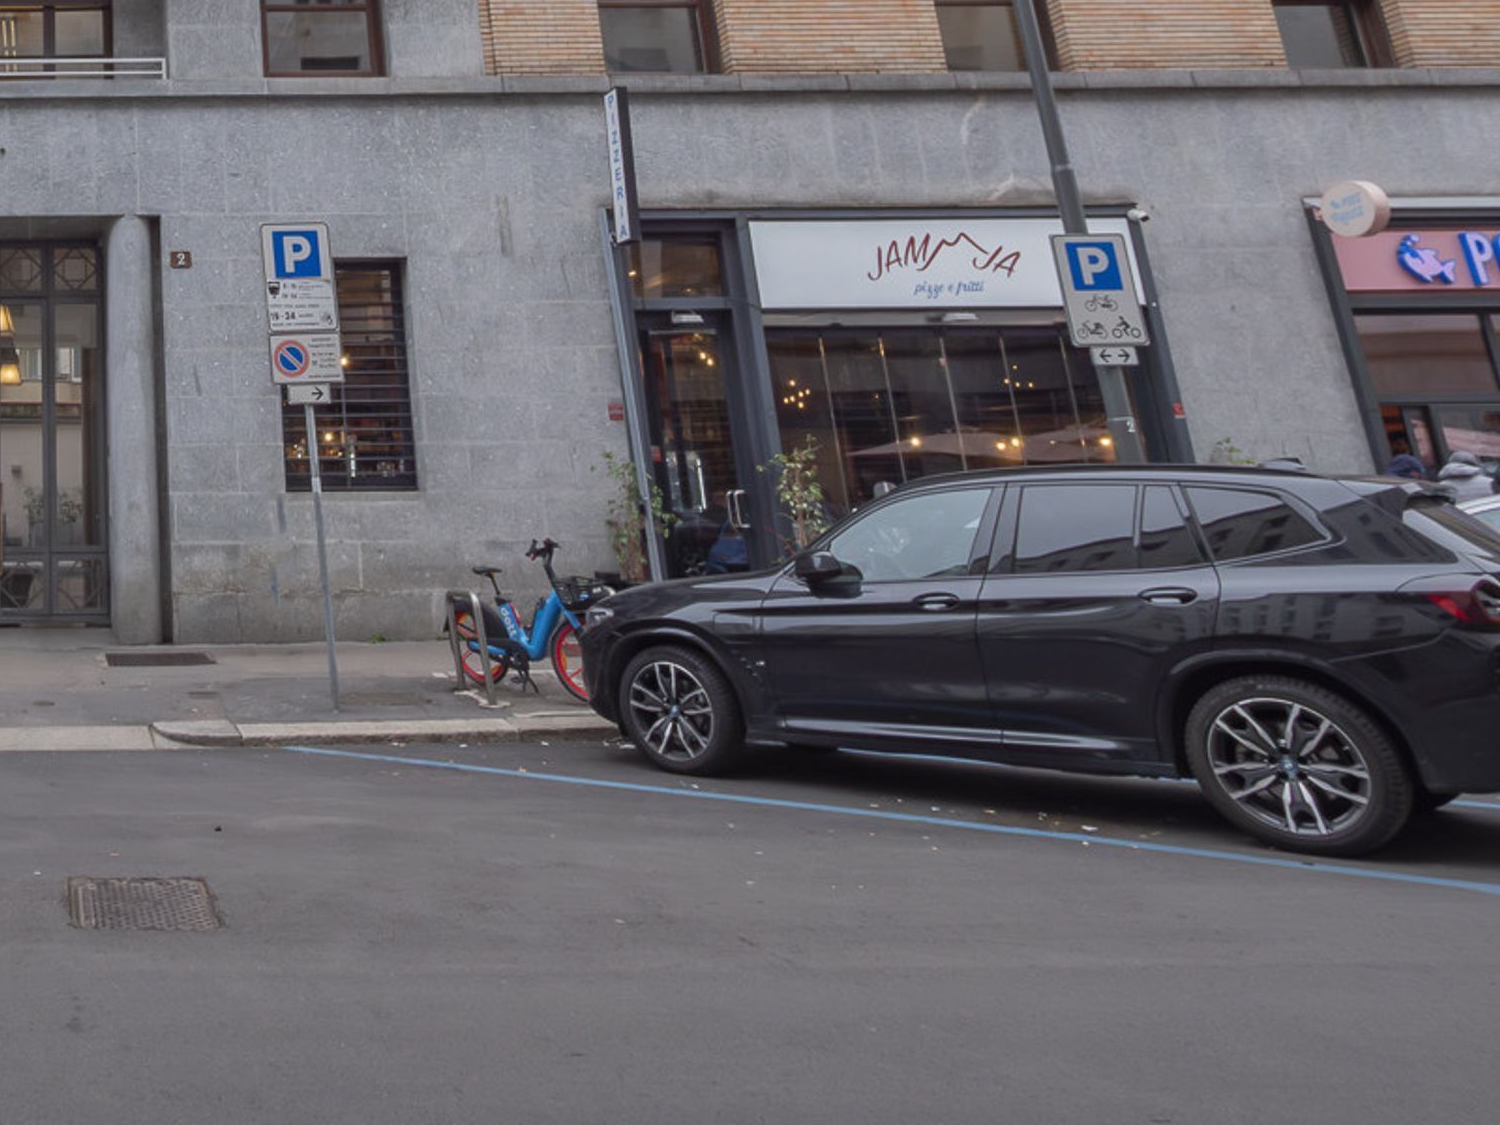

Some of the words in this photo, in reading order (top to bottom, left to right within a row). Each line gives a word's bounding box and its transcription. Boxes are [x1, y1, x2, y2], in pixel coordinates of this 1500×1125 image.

[607, 95, 628, 237] PIZZERIA
[176, 253, 186, 266] 2
[283, 235, 312, 274] P
[1075, 246, 1110, 286] P
[1457, 232, 1500, 286] P
[914, 281, 945, 299] pizze
[955, 280, 985, 297] fritti
